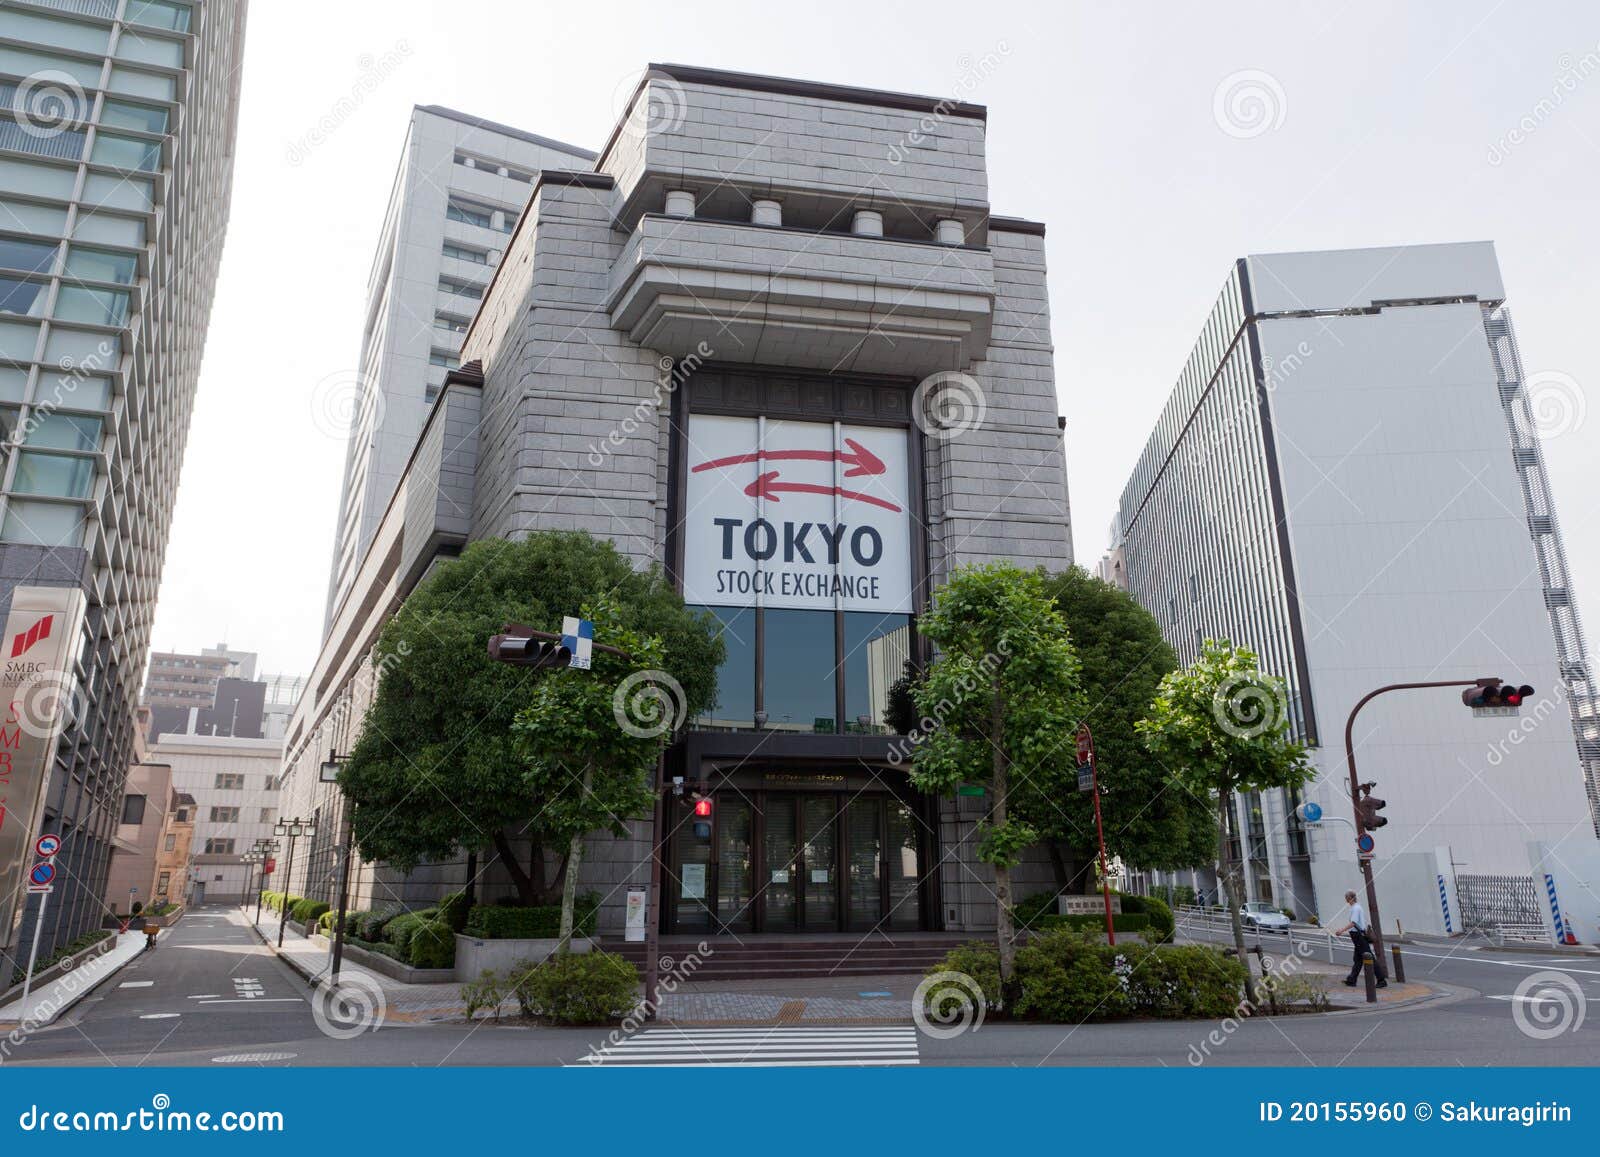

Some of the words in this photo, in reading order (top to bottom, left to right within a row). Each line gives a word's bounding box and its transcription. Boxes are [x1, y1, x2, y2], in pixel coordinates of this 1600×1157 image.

[714, 517, 883, 567] TOKYO
[717, 569, 775, 595] STOCK
[781, 572, 880, 599] EXCHANGE
[3, 672, 44, 682] NIKKO
[5, 661, 46, 673] SMBC
